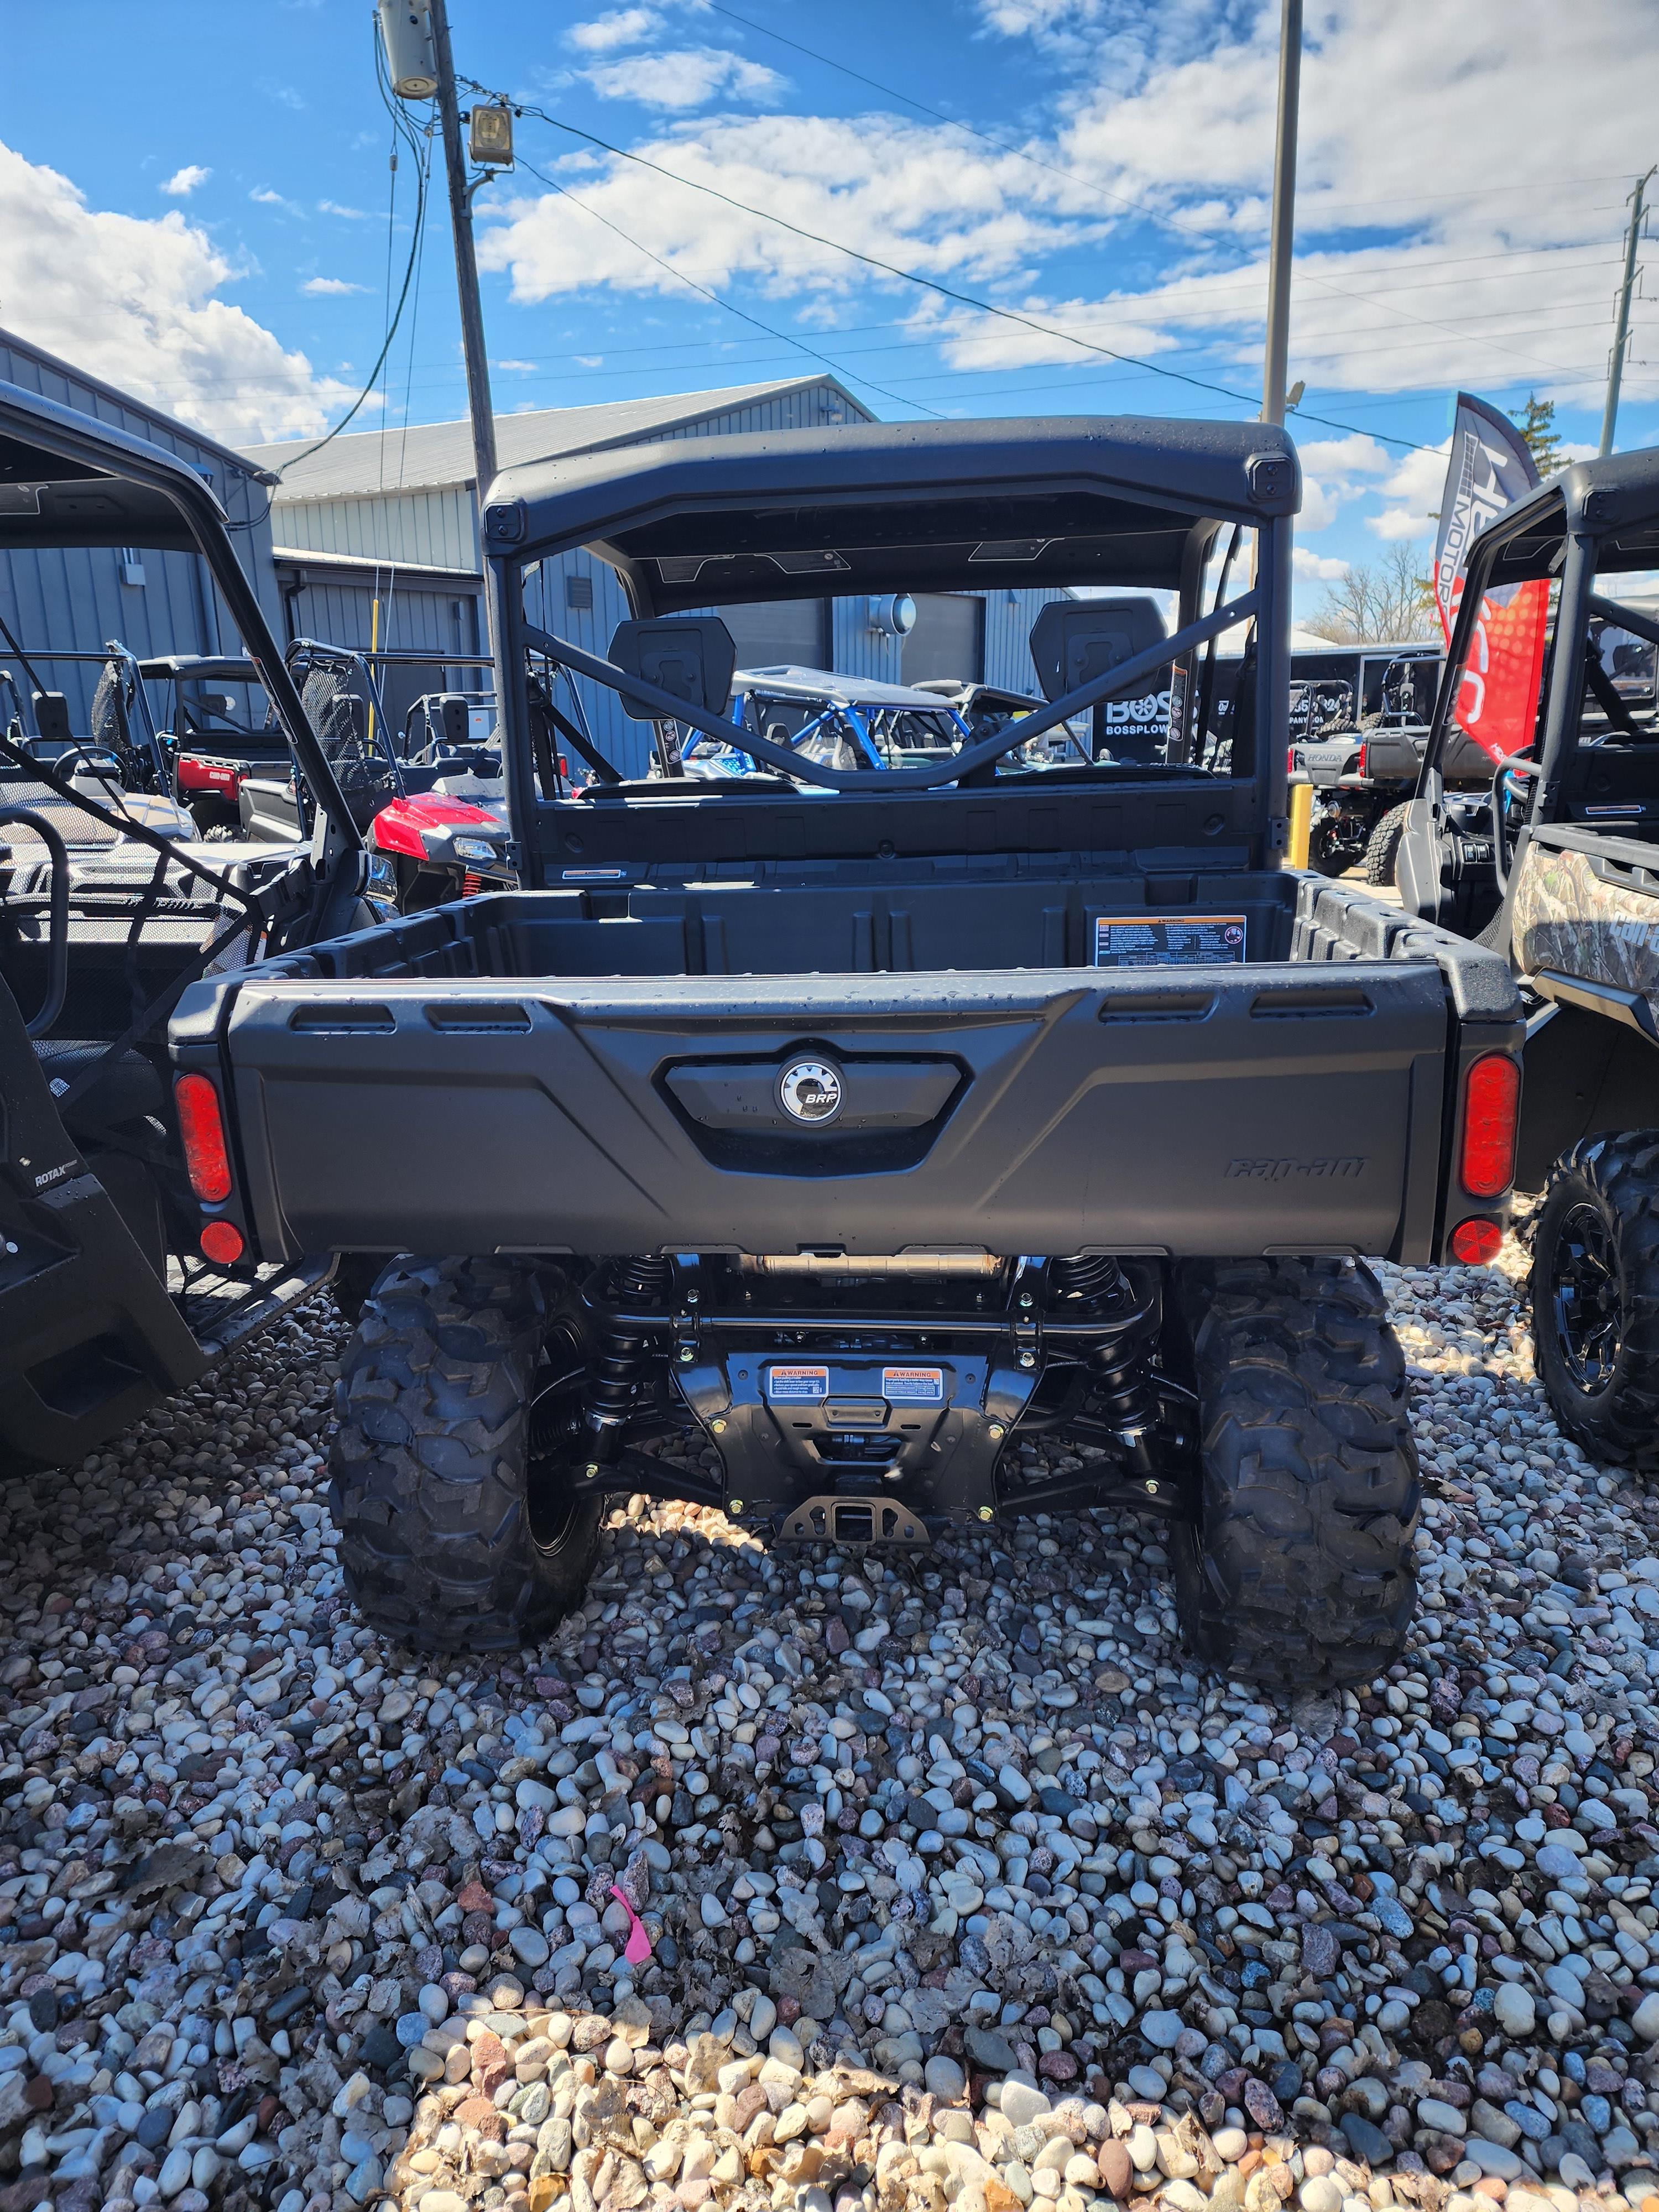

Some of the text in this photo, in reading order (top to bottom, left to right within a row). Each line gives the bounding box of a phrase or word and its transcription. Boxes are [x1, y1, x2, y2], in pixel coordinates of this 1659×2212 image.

[1308, 753, 1343, 762] HONDA
[805, 1093, 837, 1103] BRP
[35, 1165, 66, 1187] ROTAX
